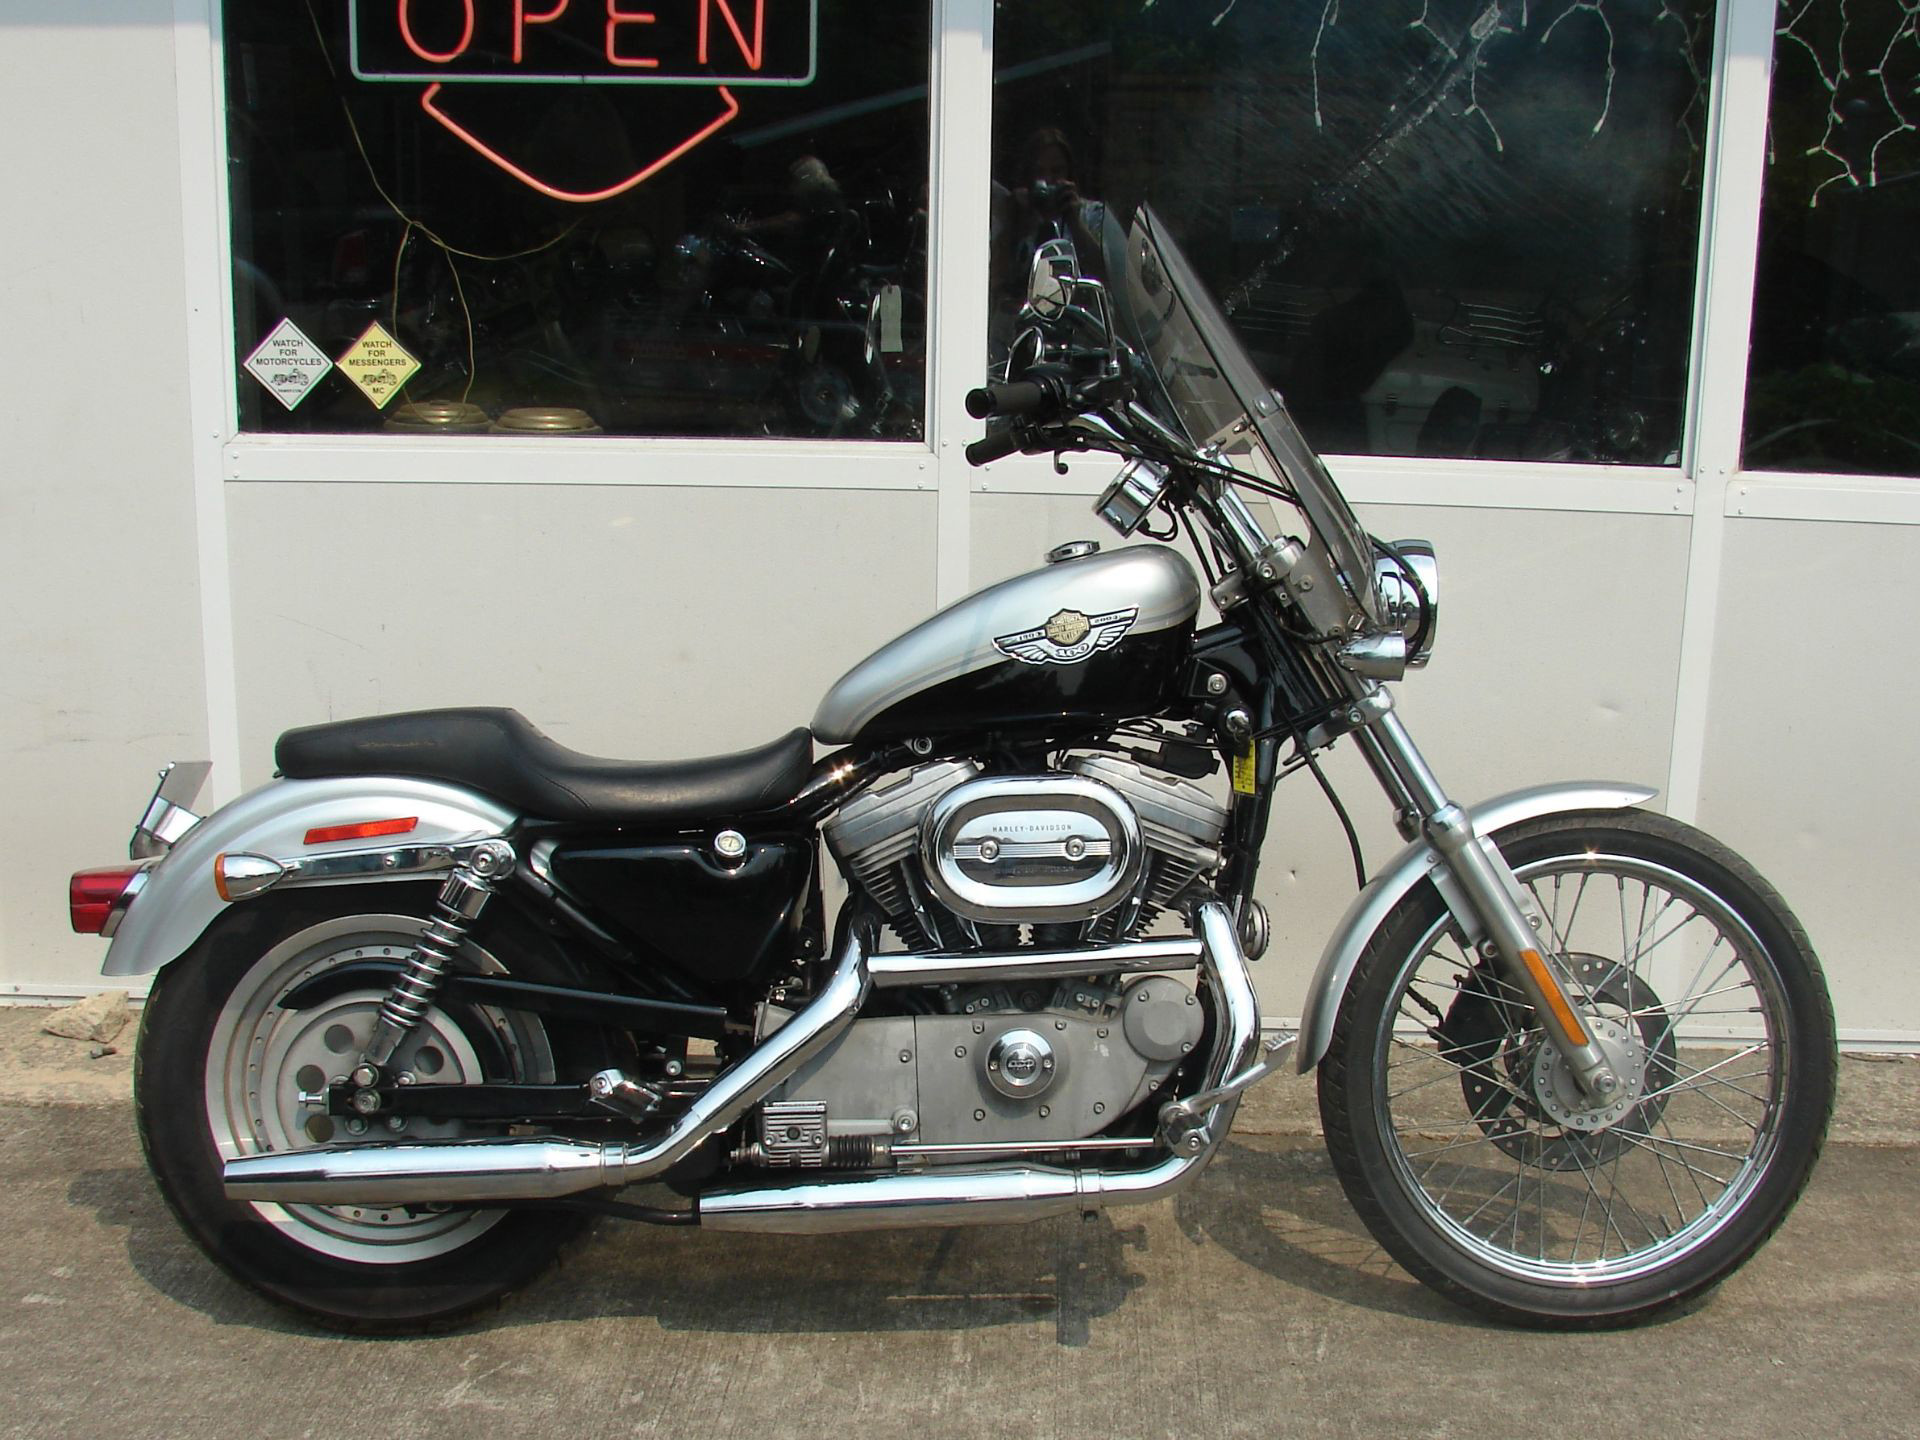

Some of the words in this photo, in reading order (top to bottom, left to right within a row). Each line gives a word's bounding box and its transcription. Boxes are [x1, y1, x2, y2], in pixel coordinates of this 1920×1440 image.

[399, 0, 765, 71] OPEN
[272, 339, 304, 348] WATCH
[361, 340, 392, 349] WATCH
[279, 349, 298, 357] FOR
[367, 350, 386, 358] FOR
[255, 358, 322, 366] MOTORCYCLES
[348, 359, 407, 367] MESSENGERS
[372, 387, 385, 395] MC
[992, 824, 1072, 833] HARLEY-DAVIDSON
